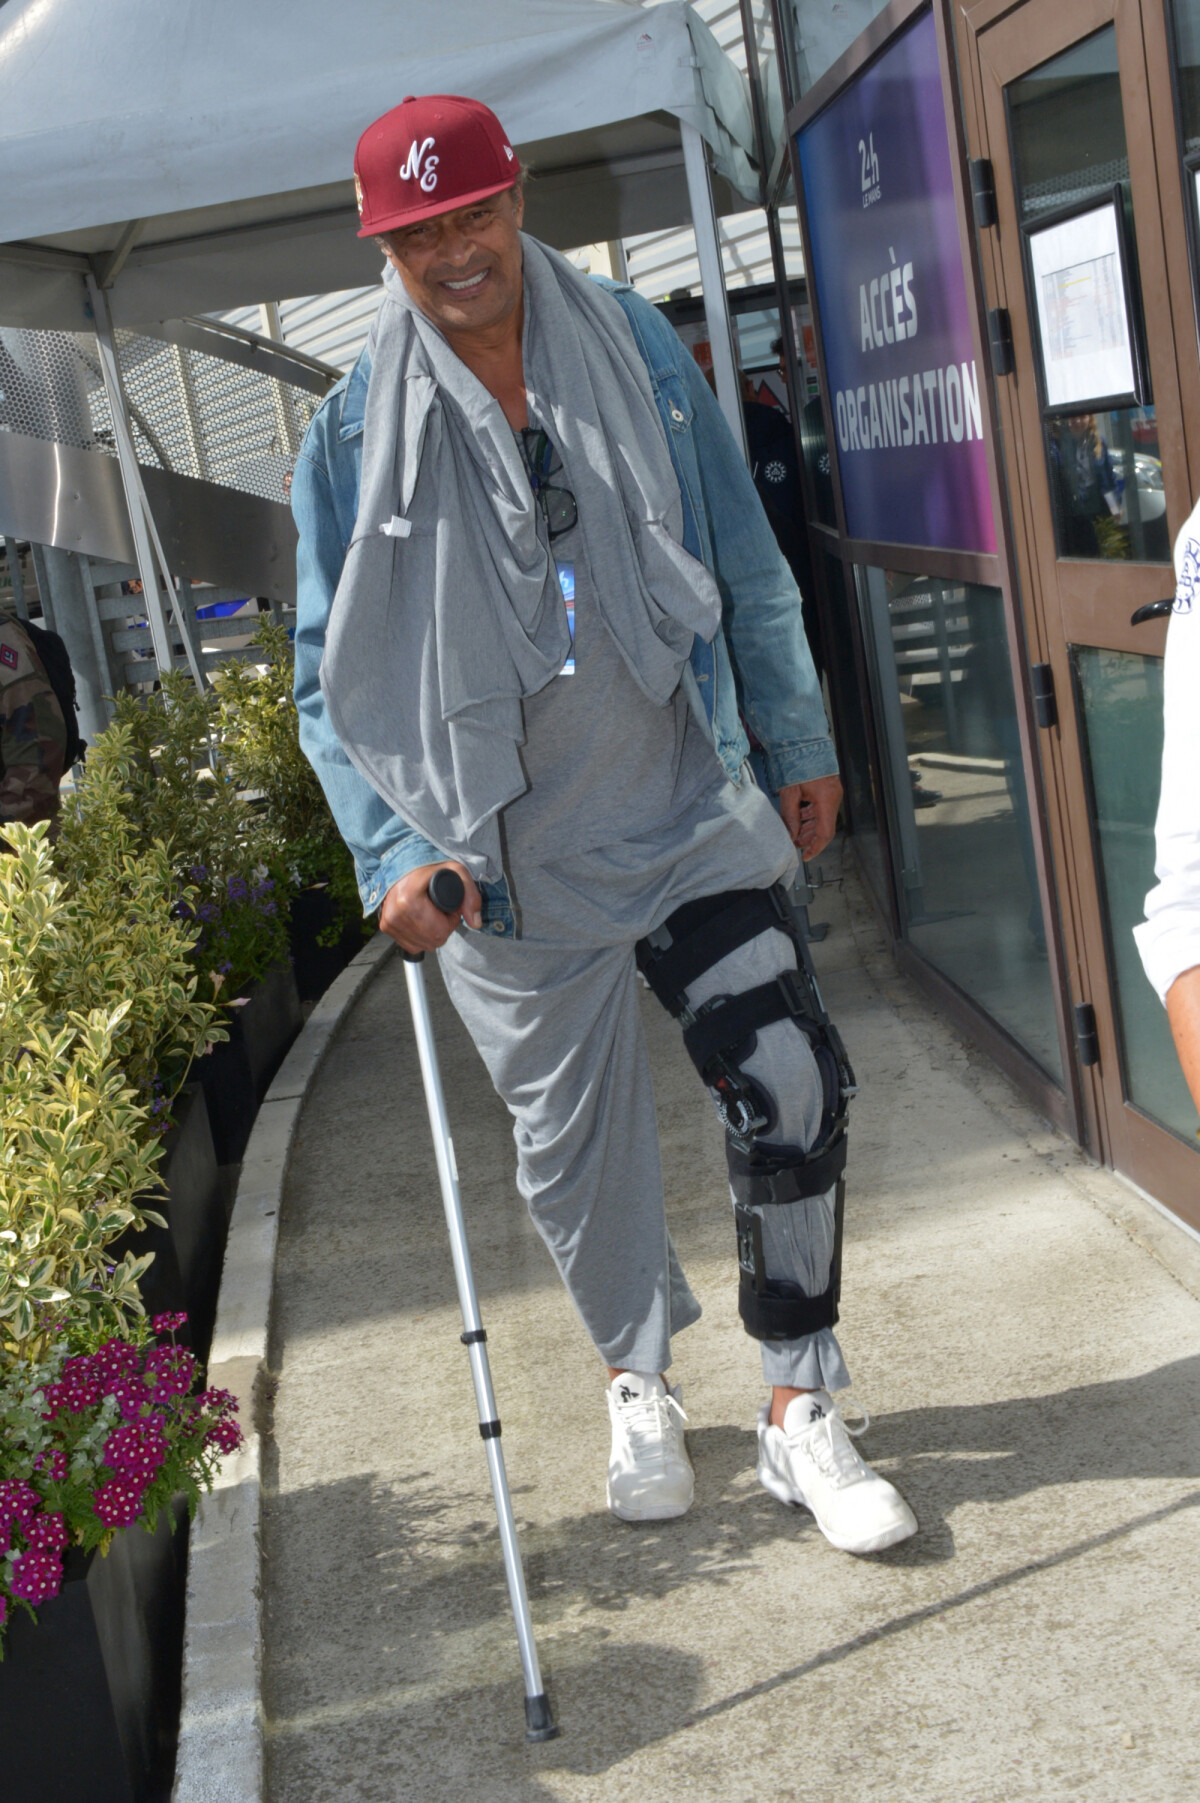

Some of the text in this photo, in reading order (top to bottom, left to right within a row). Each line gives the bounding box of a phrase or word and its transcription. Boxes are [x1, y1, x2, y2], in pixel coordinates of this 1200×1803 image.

[399, 136, 440, 193] NE
[858, 131, 880, 192] 24h
[867, 185, 882, 205] MANS
[860, 246, 918, 353] ACCÈS
[836, 360, 983, 452] ORGANISATION
